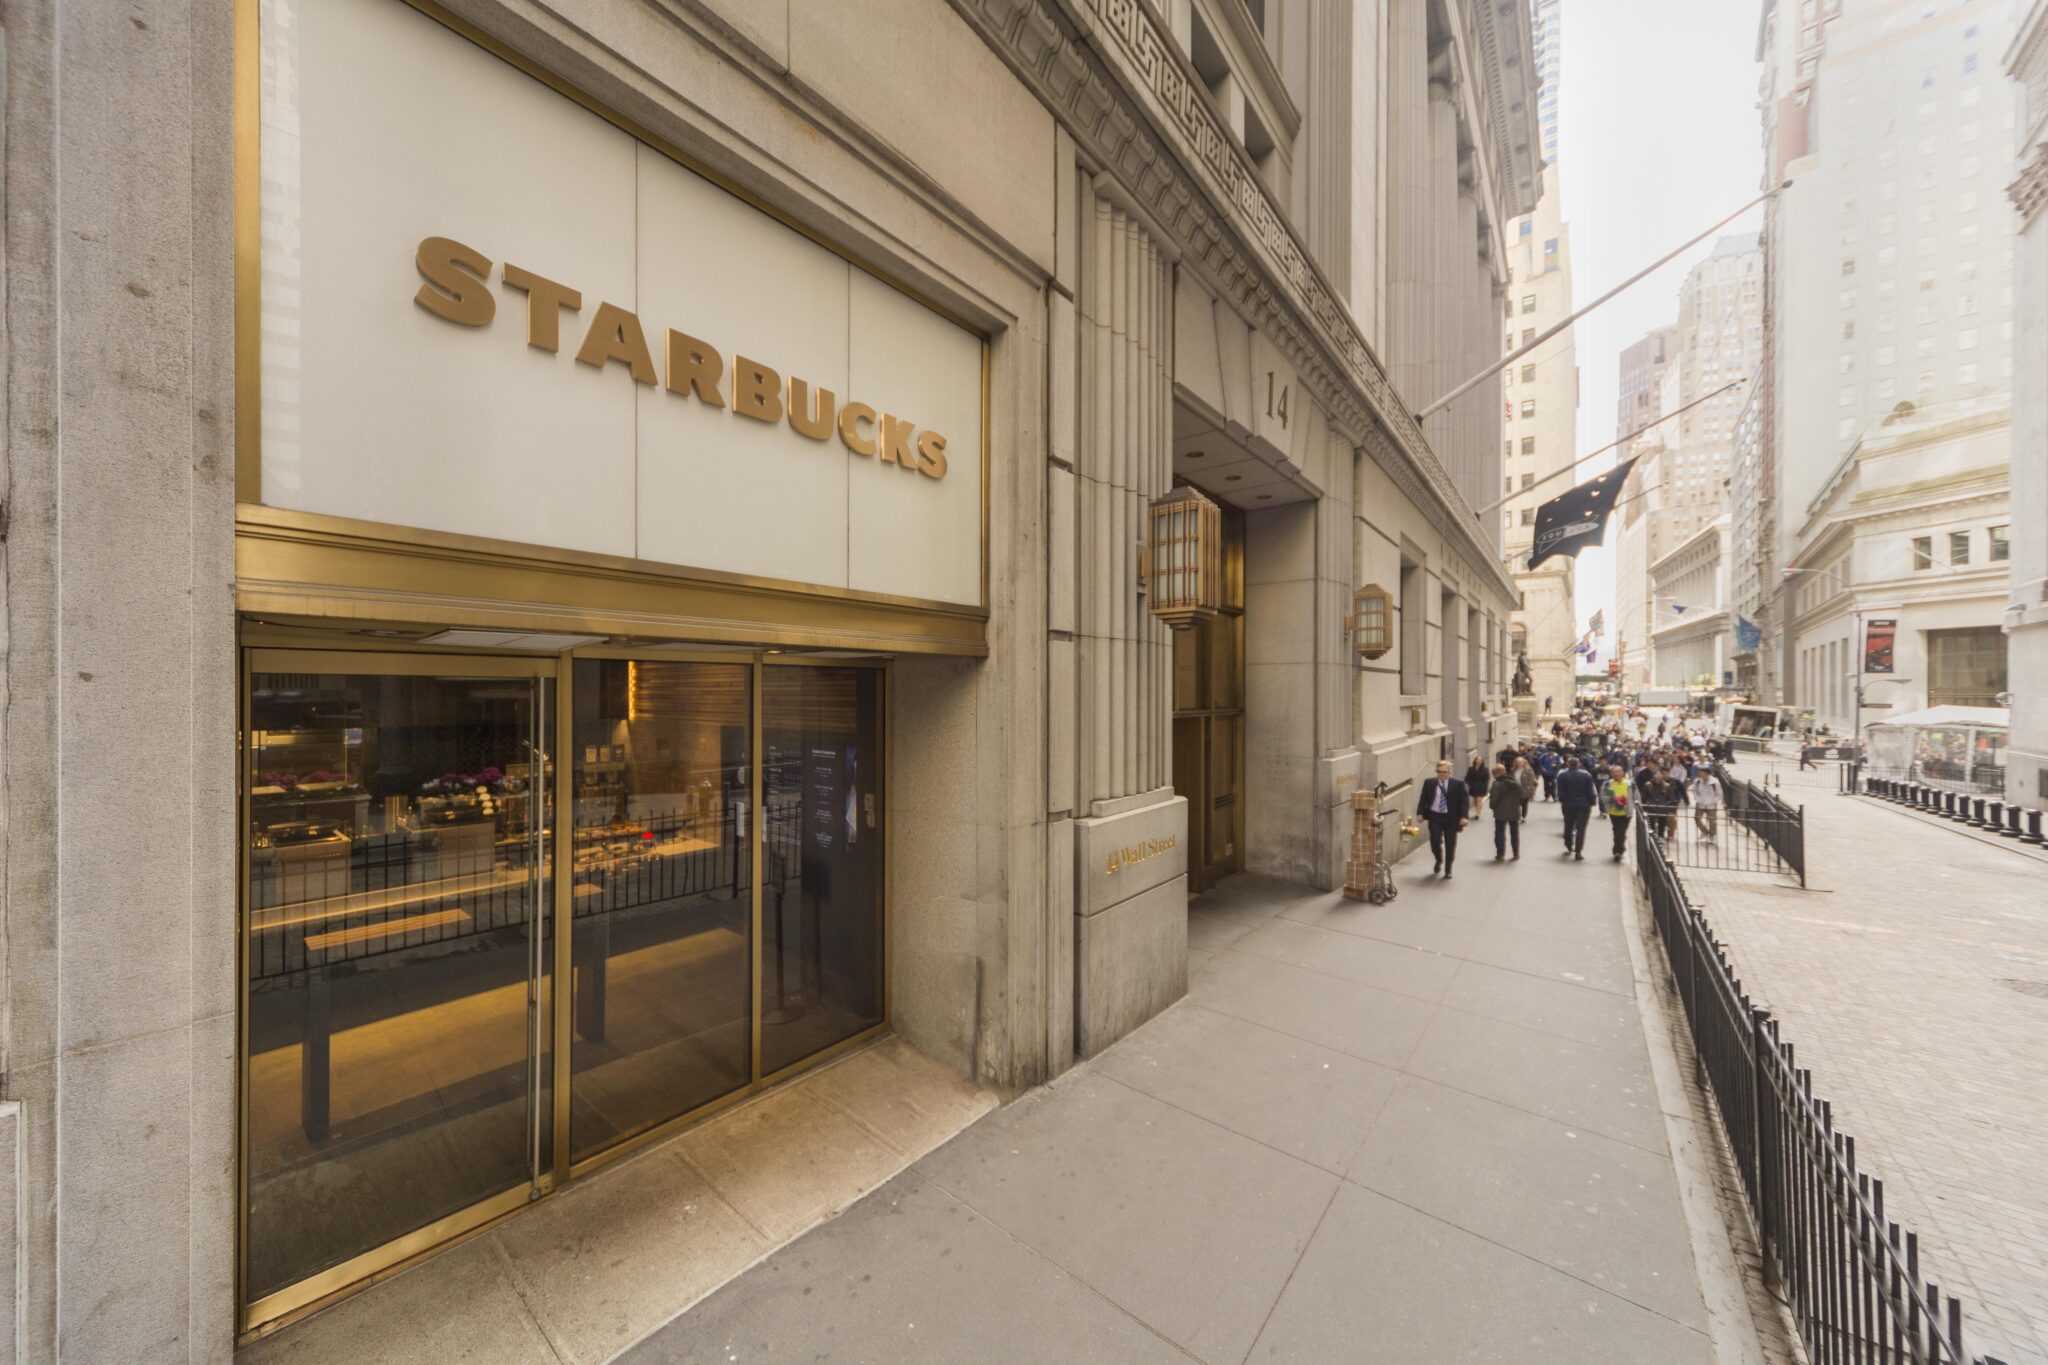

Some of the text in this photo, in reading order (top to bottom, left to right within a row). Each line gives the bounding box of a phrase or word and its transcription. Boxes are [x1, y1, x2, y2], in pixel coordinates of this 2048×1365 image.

[413, 236, 948, 480] STARBUCKS
[1266, 370, 1288, 430] 14
[1106, 833, 1175, 874] 14 Wall Street
